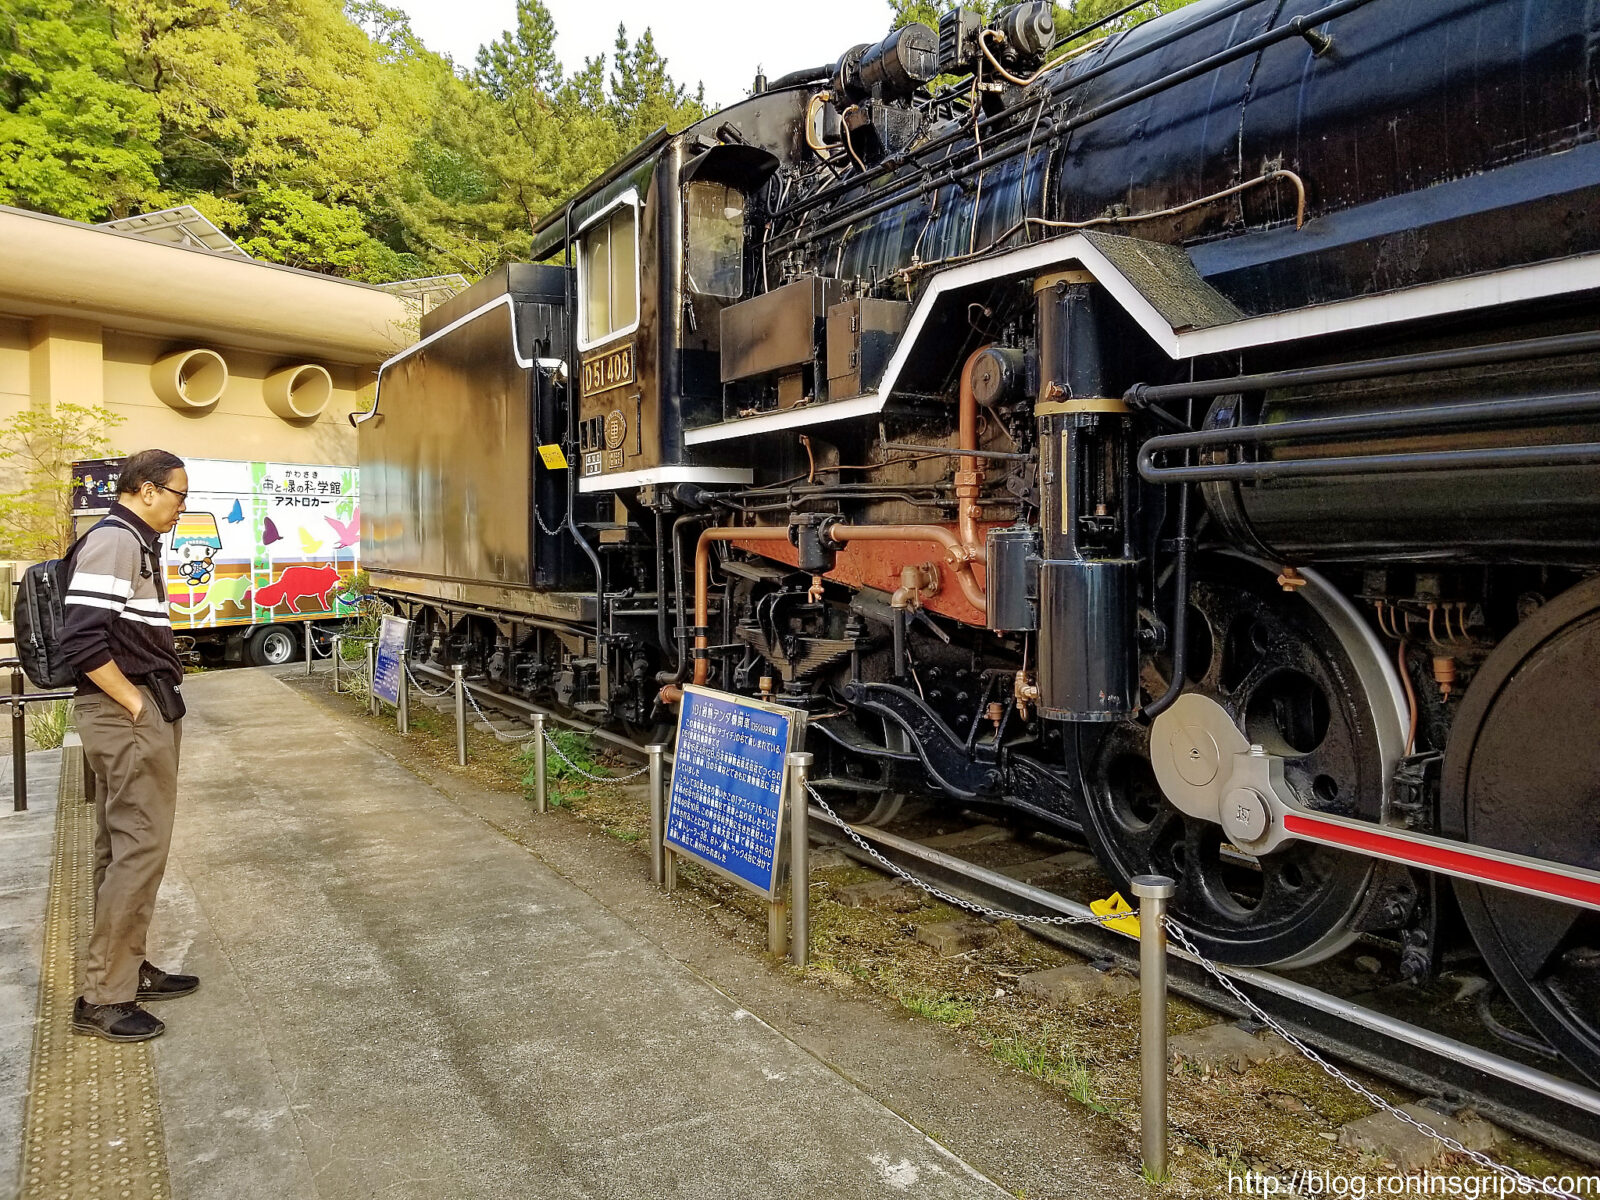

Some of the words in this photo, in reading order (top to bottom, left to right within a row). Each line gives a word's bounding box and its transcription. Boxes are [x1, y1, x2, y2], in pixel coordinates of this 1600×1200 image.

[607, 351, 629, 382] 408
[285, 470, 319, 479] かわさき
[275, 496, 330, 507] アストロカー
